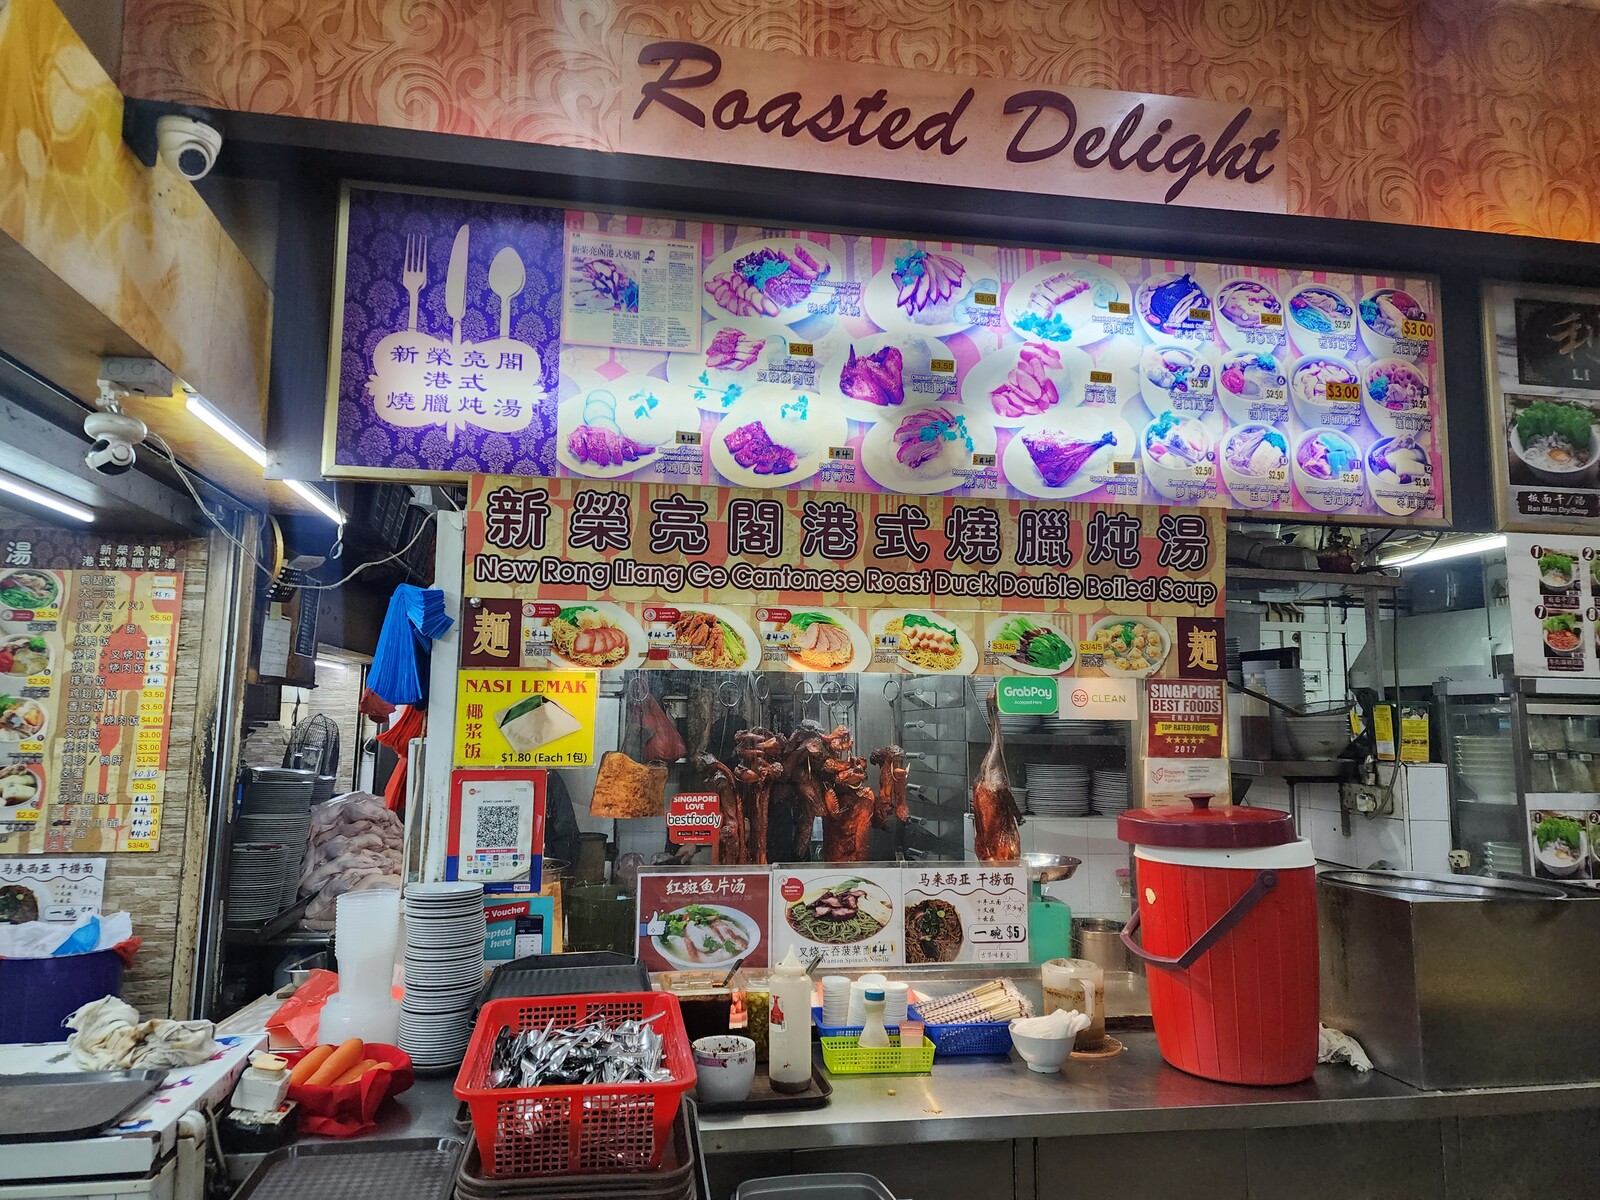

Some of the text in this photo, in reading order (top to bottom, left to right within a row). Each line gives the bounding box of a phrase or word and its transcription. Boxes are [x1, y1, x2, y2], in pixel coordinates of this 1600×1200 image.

[632, 41, 1282, 205] Roasted Delight
[975, 294, 996, 304] $3.00
[1109, 304, 1129, 313] $3.00
[969, 314, 1001, 327] 叉烧饭
[1334, 320, 1351, 329] $2.50
[1403, 321, 1433, 337] $3.00
[790, 345, 813, 354] $4.00
[390, 345, 523, 371] 新榮亮閣
[931, 361, 954, 370] $3.50
[423, 371, 488, 392] 港式
[1091, 373, 1112, 382] $3.50
[1191, 379, 1208, 388] $2.50
[1266, 389, 1284, 399] $2.50
[1327, 385, 1359, 399] $3.00
[385, 391, 523, 418] 燒臘炖湯
[1411, 399, 1427, 409] $2.50
[654, 462, 703, 475] 烧鸡腿饭
[1195, 466, 1212, 476] $2.50
[820, 471, 855, 483] 排骨饭
[1268, 471, 1285, 480] $2.50
[1342, 473, 1358, 483] $2.50
[964, 476, 997, 489] 烧鸭饭
[488, 487, 1211, 570] 新榮亮閣港式燒臘炖湯
[5, 541, 33, 566] 湯
[100, 544, 162, 557] 新榮亮閣
[1535, 547, 1540, 558] 1
[1585, 548, 1591, 559] 2
[81, 555, 176, 570] 港式燒臘炖湯
[475, 554, 1218, 607] New Rong Liang Ge Cantonese Roast Duck Double Boiled Soup
[79, 588, 115, 598] 大三元
[77, 611, 113, 622] 小三元
[1538, 608, 1544, 618] 7
[75, 635, 110, 647] 烧鸭饭
[992, 642, 1016, 651] $3/4/5
[1080, 643, 1103, 651] $3/4/5
[70, 675, 106, 687] 排骨饭
[465, 679, 588, 694] NASI LEMAK
[1003, 686, 1053, 700] GrabPay
[1150, 683, 1221, 699] SINGAPORE
[1073, 694, 1126, 703] SG CLEAN
[68, 701, 104, 712] 香肠饭
[141, 703, 163, 711] $3.50
[1152, 699, 1219, 713] BEST FOODS
[1171, 714, 1201, 722] ENJOY
[464, 703, 484, 759] 椰浆饭
[1161, 723, 1173, 731] TOP
[65, 728, 102, 740] 叉烧饭
[139, 731, 161, 739] $3.00
[19, 743, 43, 751] $2.50
[63, 741, 100, 753] 烧肉饭
[1174, 745, 1197, 753] 2017
[501, 753, 531, 763] $1.80
[534, 753, 563, 764] (Each
[673, 795, 718, 803] SINGAPORE
[16, 811, 39, 819] $2.50
[667, 812, 722, 828] bestfoody
[1536, 812, 1541, 823] 1
[1591, 812, 1597, 823] 2
[2, 862, 94, 875] 马来西亚 干捞面
[919, 872, 1015, 888] 马来西亚 干捞面
[666, 876, 747, 896] 红斑鱼片汤
[50, 906, 78, 918] 一碗
[491, 906, 526, 918] Voucher
[485, 927, 513, 939] epted
[974, 925, 1020, 940] 一碗 $5
[490, 938, 513, 949] here
[845, 956, 868, 965] Spinach
[869, 955, 890, 963] Noodle
